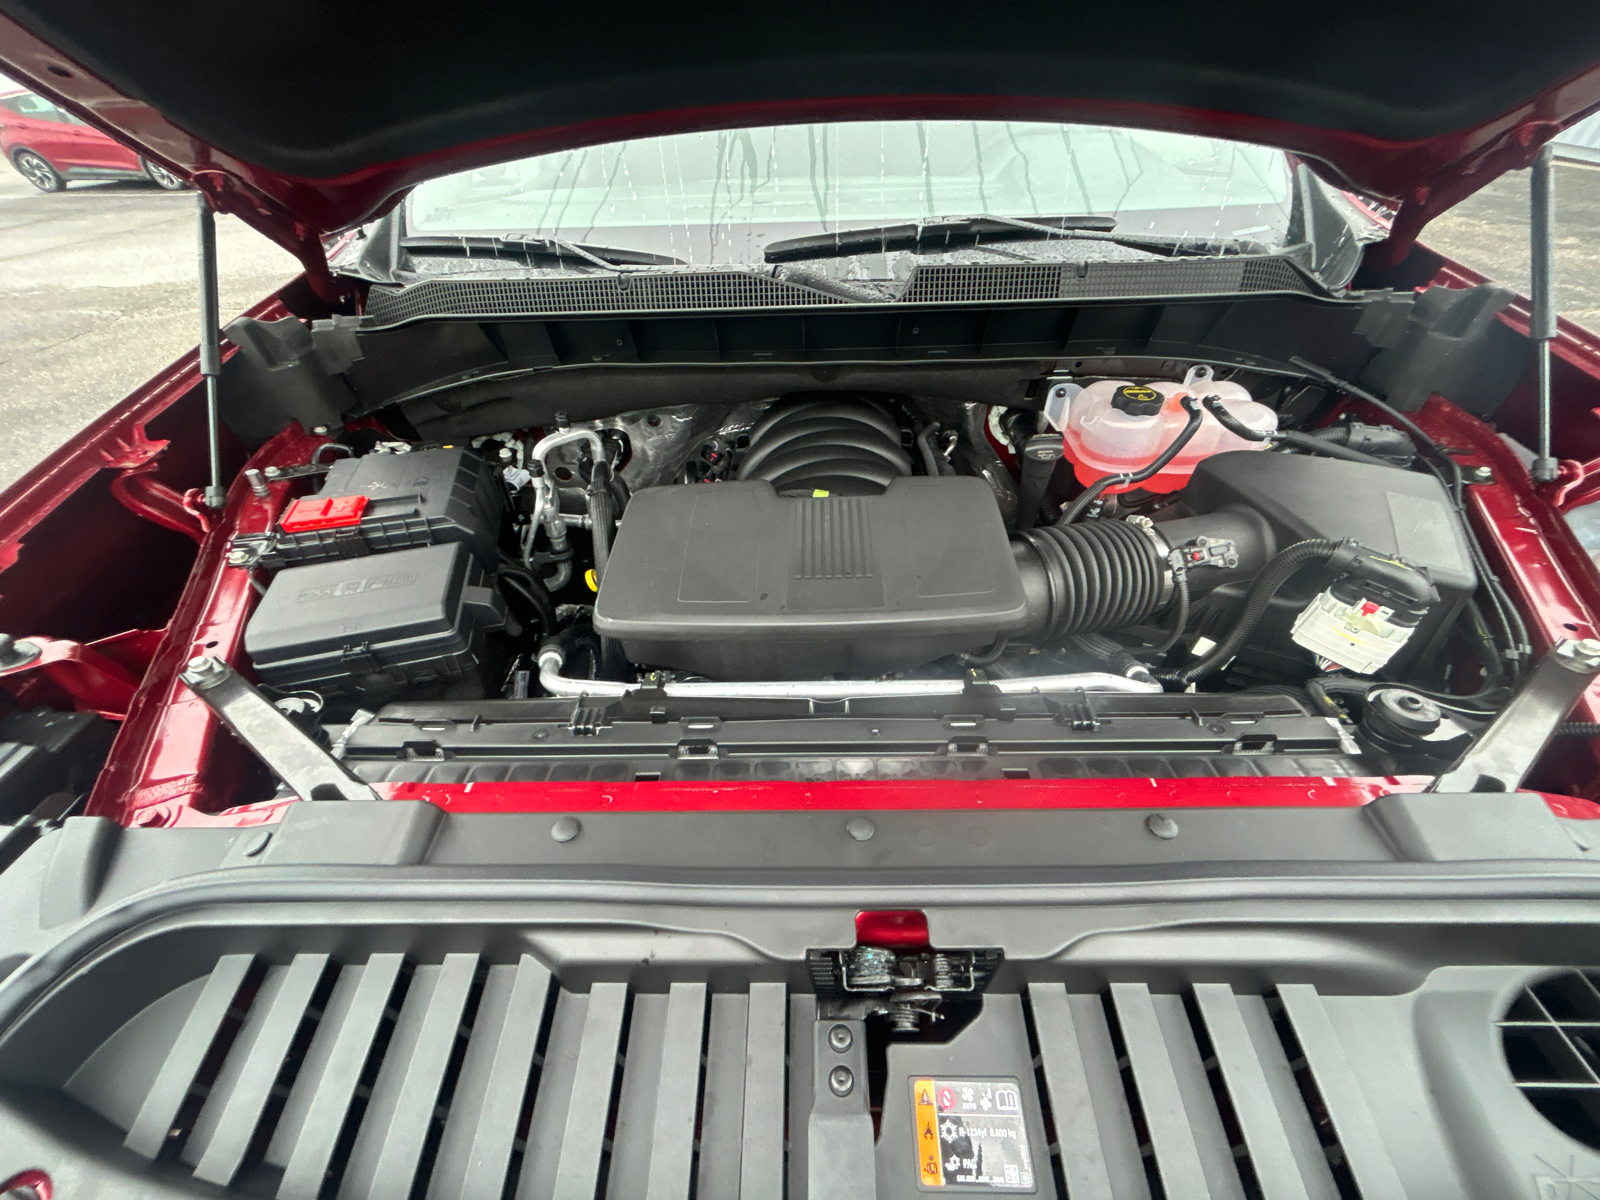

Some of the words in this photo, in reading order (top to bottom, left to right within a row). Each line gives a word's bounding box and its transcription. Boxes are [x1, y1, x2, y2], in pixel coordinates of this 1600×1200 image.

[962, 1102, 977, 1111] AUTO
[1007, 1127, 1017, 1140] kg
[962, 1158, 977, 1170] PAG
